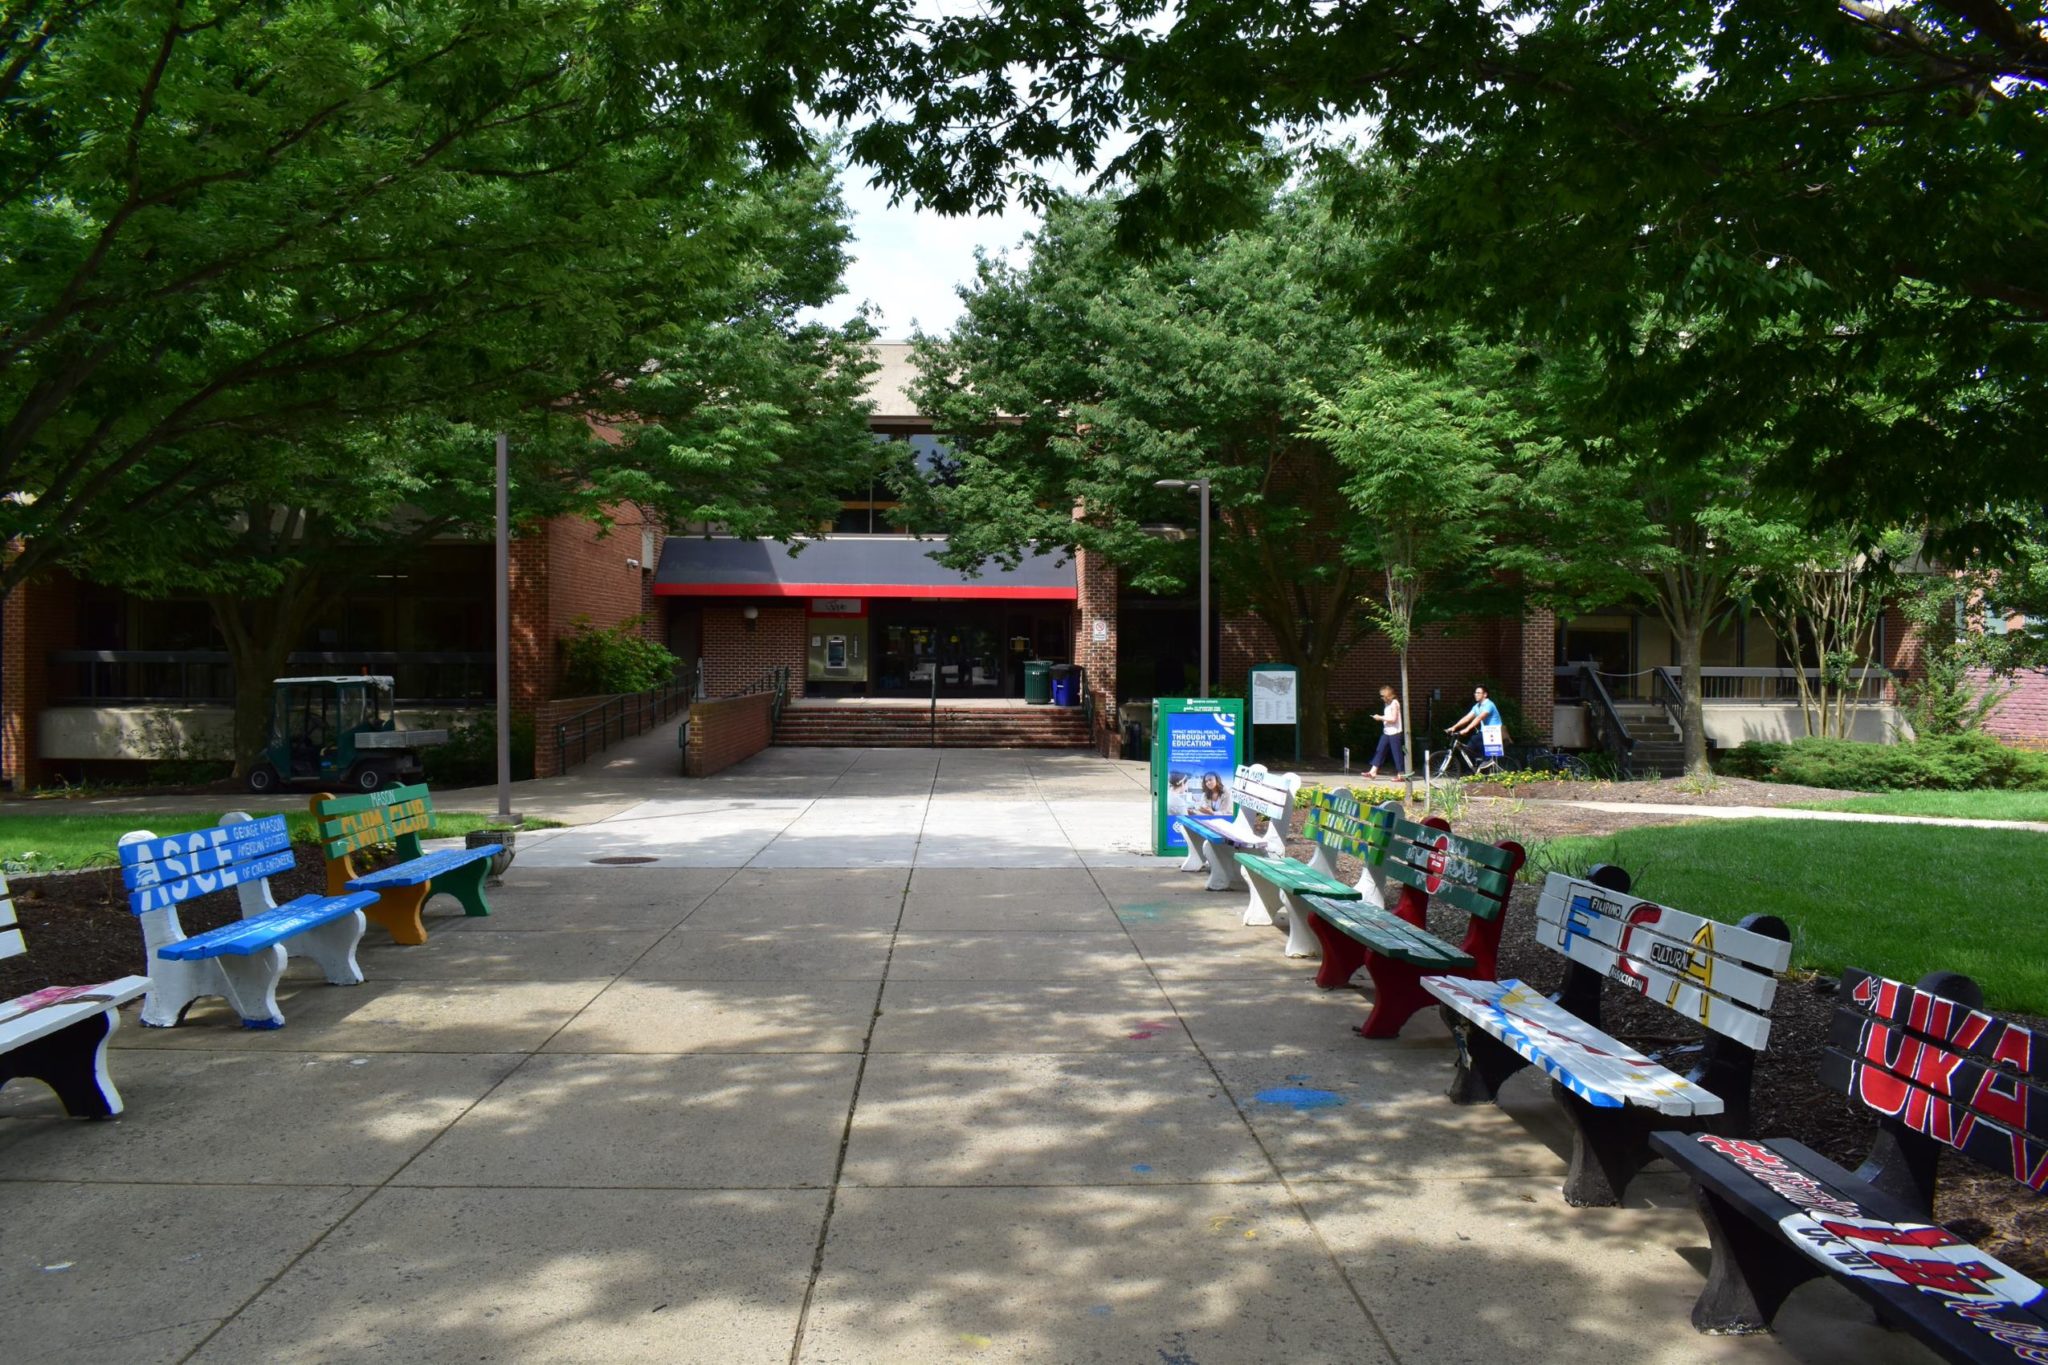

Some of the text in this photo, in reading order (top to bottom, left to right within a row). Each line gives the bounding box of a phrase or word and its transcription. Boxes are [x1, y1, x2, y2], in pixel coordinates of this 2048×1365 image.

[370, 790, 396, 806] MASON
[233, 817, 286, 840] GEORGE MASON
[389, 799, 429, 836] CLUB
[238, 832, 288, 857] AMERICAN SOCIETY
[135, 829, 238, 911] ASCE
[242, 854, 294, 879] OF CIVIL ENGINEERS
[1592, 898, 1621, 917] FILIPINO
[1651, 944, 1688, 970] CULTURAL
[1609, 966, 1643, 992] ASSOCIATION
[1797, 1228, 1846, 1246] UK
